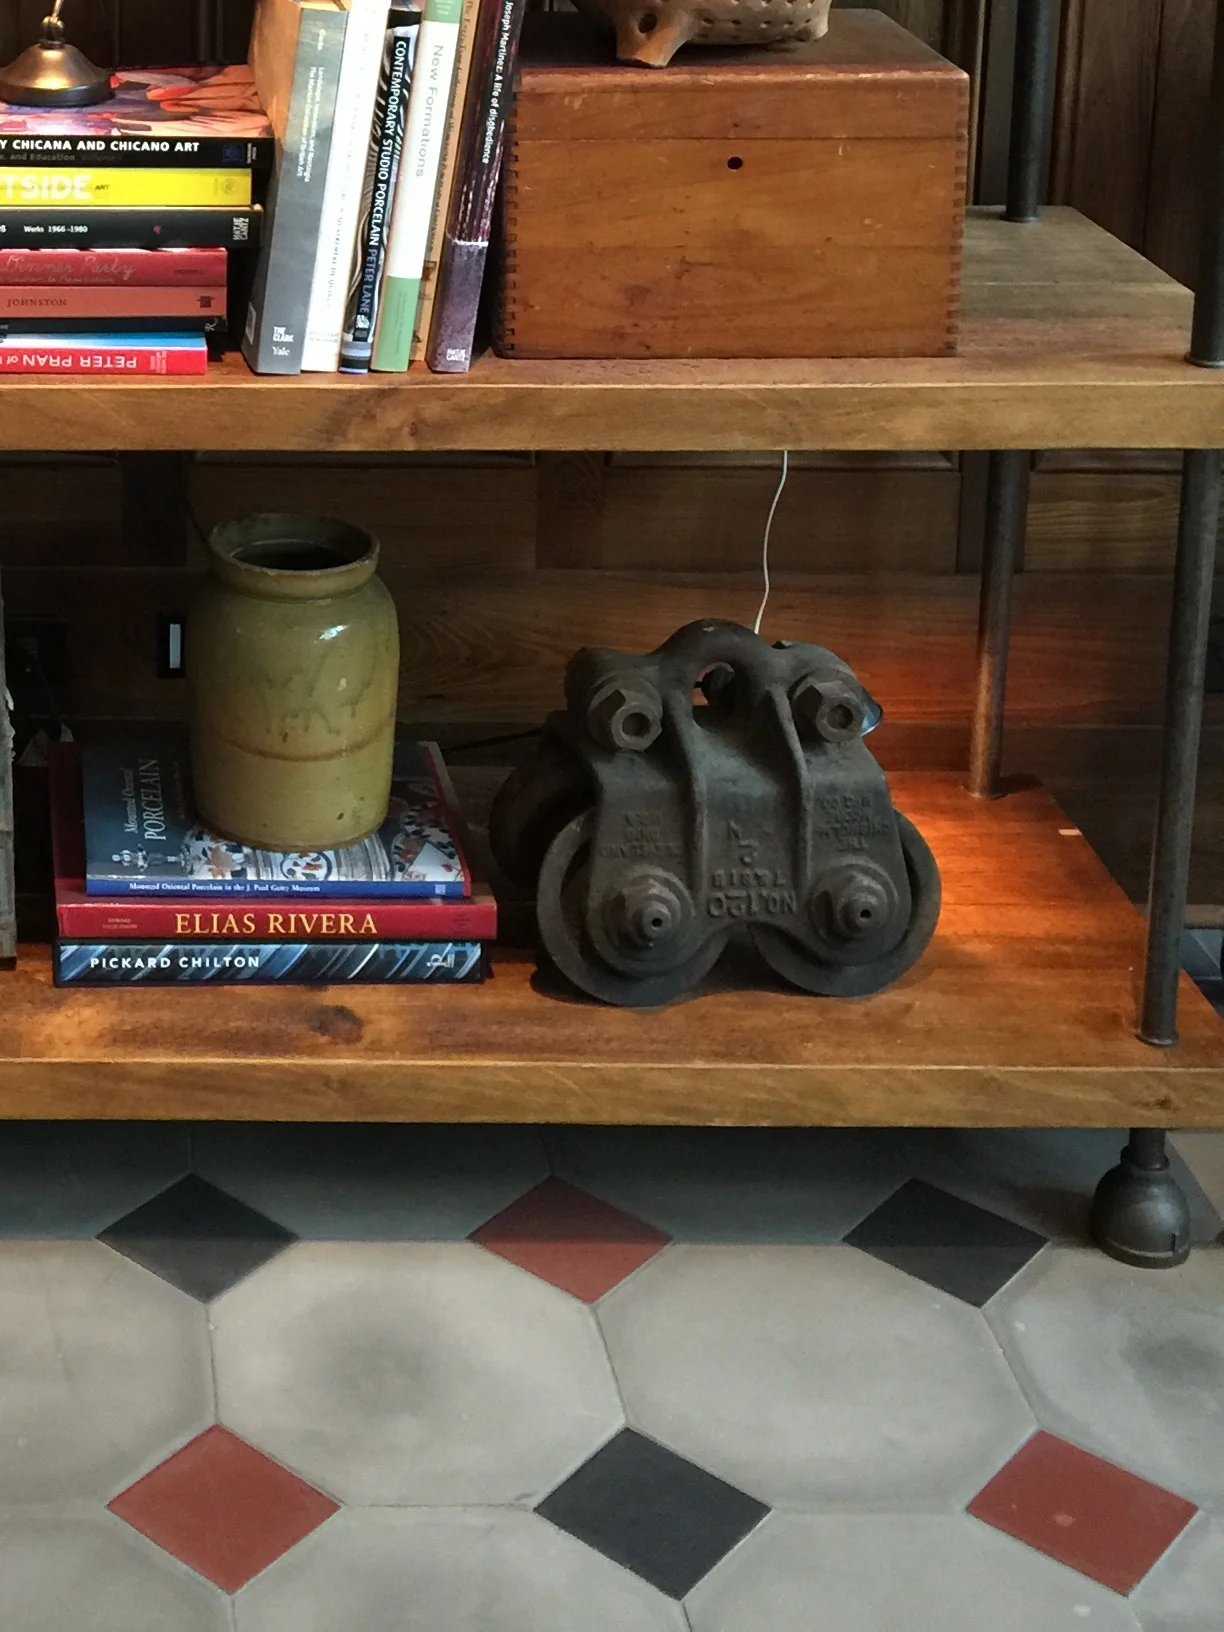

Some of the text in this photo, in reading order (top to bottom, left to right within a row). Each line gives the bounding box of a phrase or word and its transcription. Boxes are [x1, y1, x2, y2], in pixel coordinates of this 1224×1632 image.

[501, 0, 515, 31] Joseph
[416, 44, 444, 178] New Formations
[12, 139, 73, 151] CHICANA
[76, 140, 106, 151] AND
[110, 140, 170, 152] CHICANO
[174, 141, 200, 153] ART
[359, 40, 407, 314] CONTEMPORARY STUDIO PORCELAIN PETER LANE
[272, 333, 294, 343] CLARK
[272, 345, 291, 356] Yale
[6, 355, 19, 365] of
[22, 355, 73, 368] PRAN
[79, 355, 137, 369] PETER
[138, 758, 167, 841] PORCELAIN
[192, 882, 270, 893] Porcelain the Paul
[175, 912, 378, 935] ELIAS RIVERA
[90, 955, 261, 970] PICKARD CHILTON
